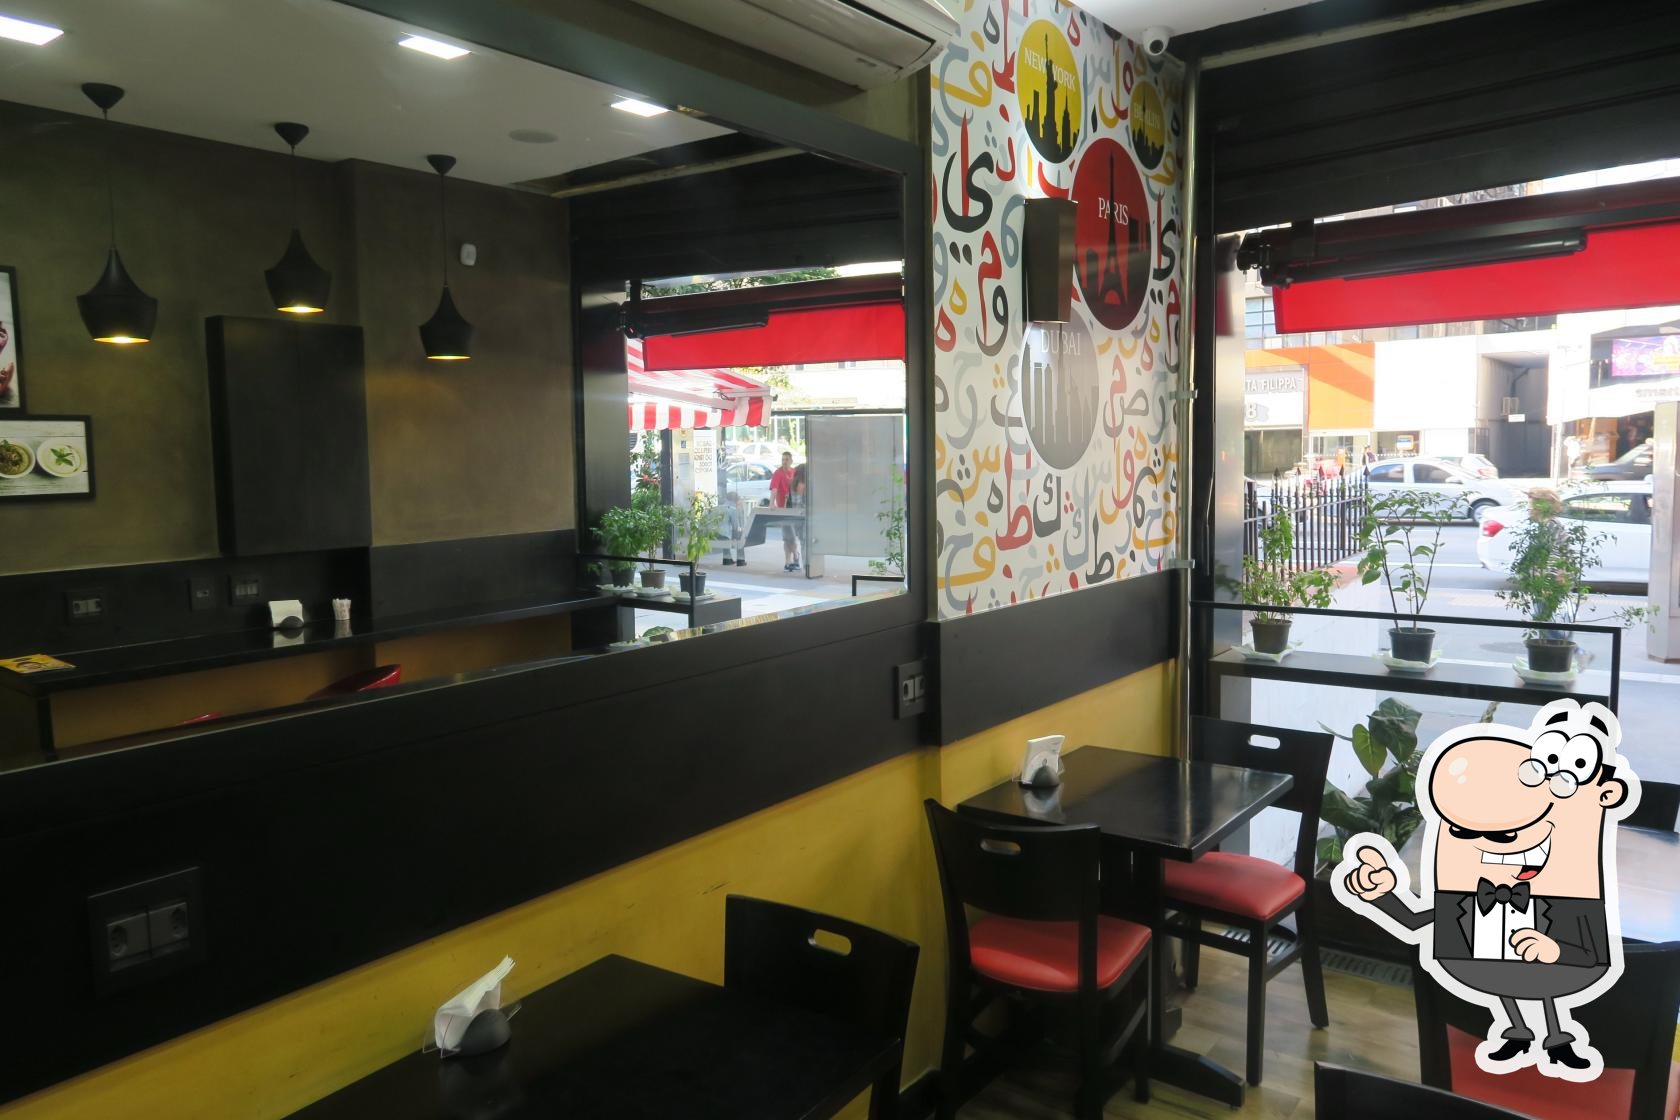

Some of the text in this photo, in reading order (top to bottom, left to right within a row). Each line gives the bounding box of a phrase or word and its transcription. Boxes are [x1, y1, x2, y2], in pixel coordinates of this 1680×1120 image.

[1024, 48, 1076, 91] NEW YORK
[1098, 197, 1129, 225] PARIS
[1040, 329, 1081, 355] DUBAI
[1262, 376, 1297, 392] FILIPPA
